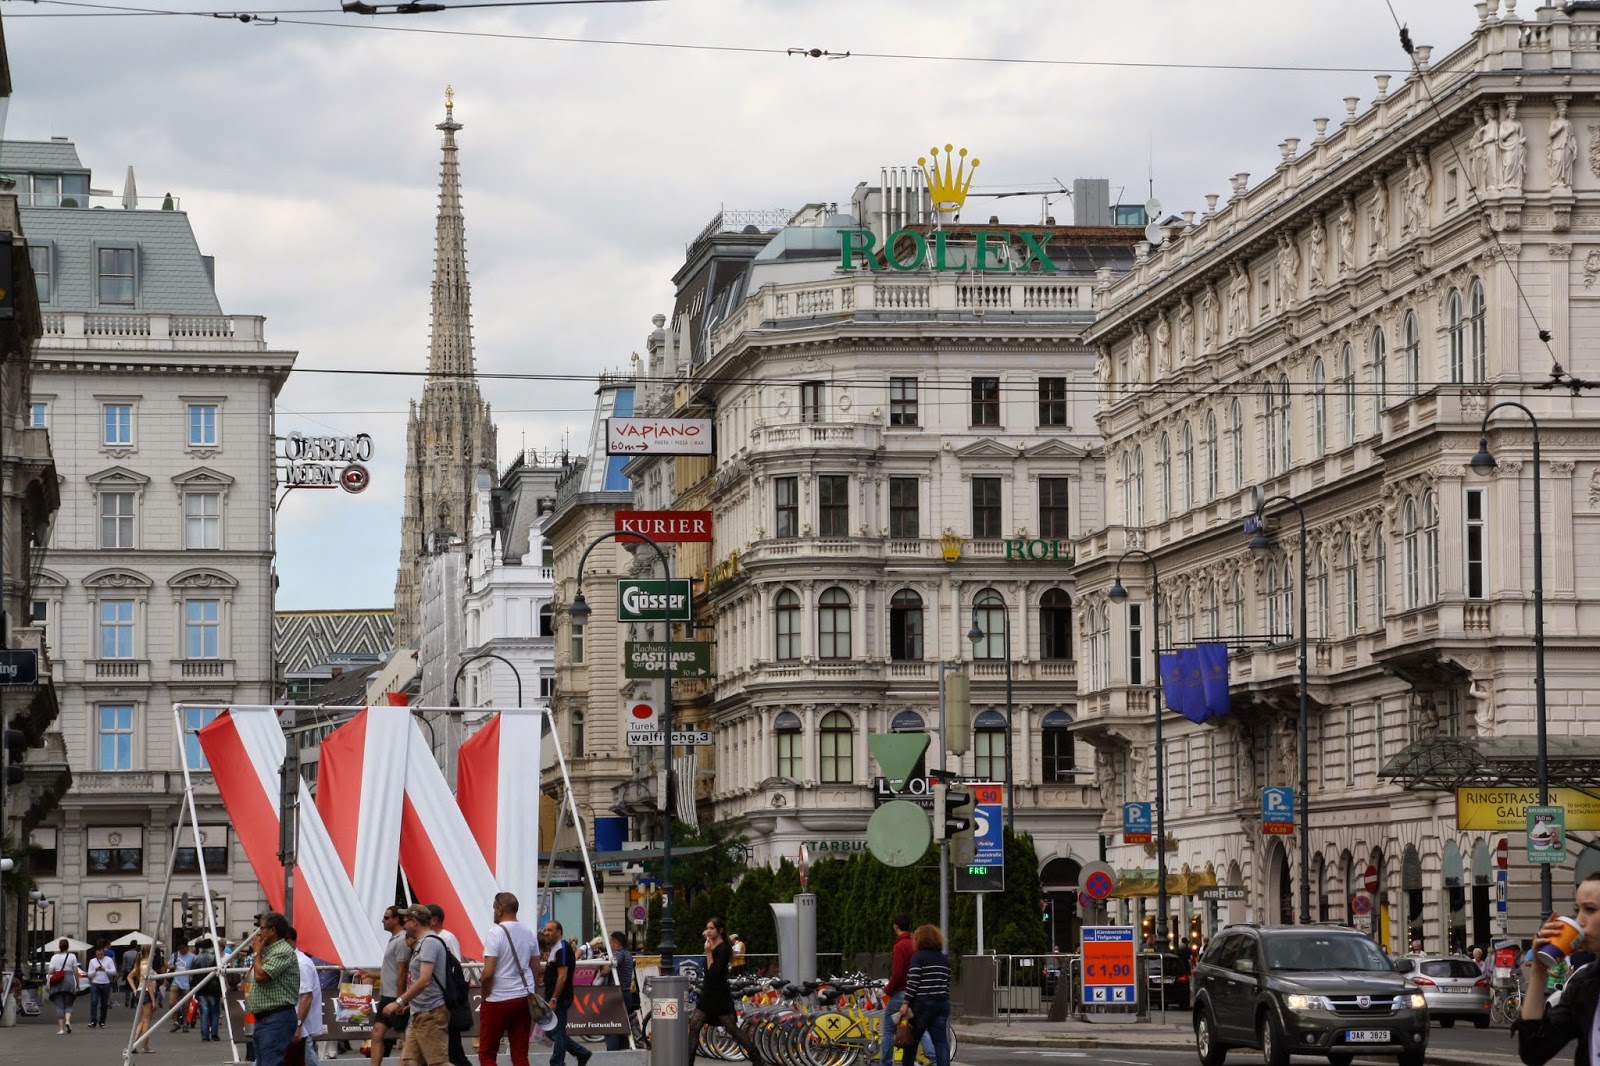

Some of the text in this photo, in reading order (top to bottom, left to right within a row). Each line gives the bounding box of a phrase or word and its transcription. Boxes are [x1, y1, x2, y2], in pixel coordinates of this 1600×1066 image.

[837, 229, 1061, 272] ROLEX
[285, 431, 374, 461] CASINO
[286, 465, 336, 484] WIEN
[622, 519, 706, 533] KURIER
[1006, 539, 1073, 560] ROL
[623, 586, 685, 614] Gösser
[0, 662, 18, 677] ing
[630, 722, 655, 730] Turek
[631, 732, 709, 743] walfichg.3
[1466, 792, 1557, 804] RINGSTRASSN
[801, 841, 871, 850] STARBUC
[1087, 964, 1130, 978] € 1,90
[1370, 1031, 1387, 1039] 3829
